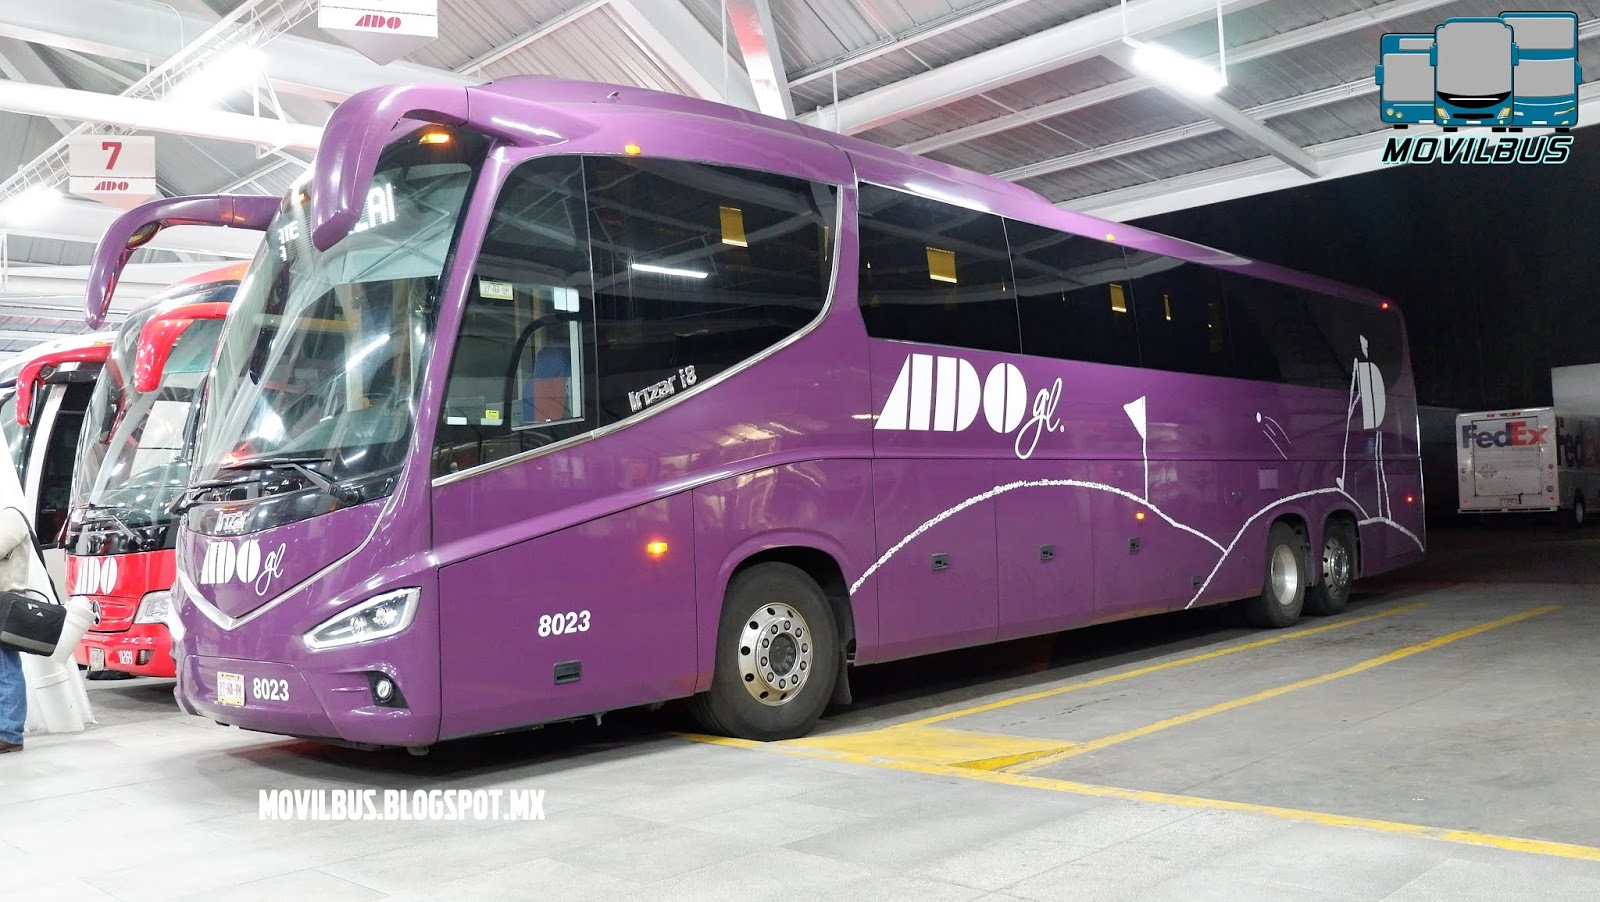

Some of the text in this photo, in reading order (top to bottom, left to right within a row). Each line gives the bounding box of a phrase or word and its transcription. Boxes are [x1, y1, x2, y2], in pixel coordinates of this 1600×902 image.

[354, 14, 402, 29] ADO
[101, 141, 123, 170] 7
[93, 181, 129, 191] ADO
[678, 364, 698, 389] i8
[873, 353, 1028, 434] ADO
[1461, 421, 1548, 449] FedEx
[74, 556, 118, 595] ADO
[200, 539, 262, 584] ADO
[537, 609, 592, 638] 8023
[252, 677, 291, 702] 8023
